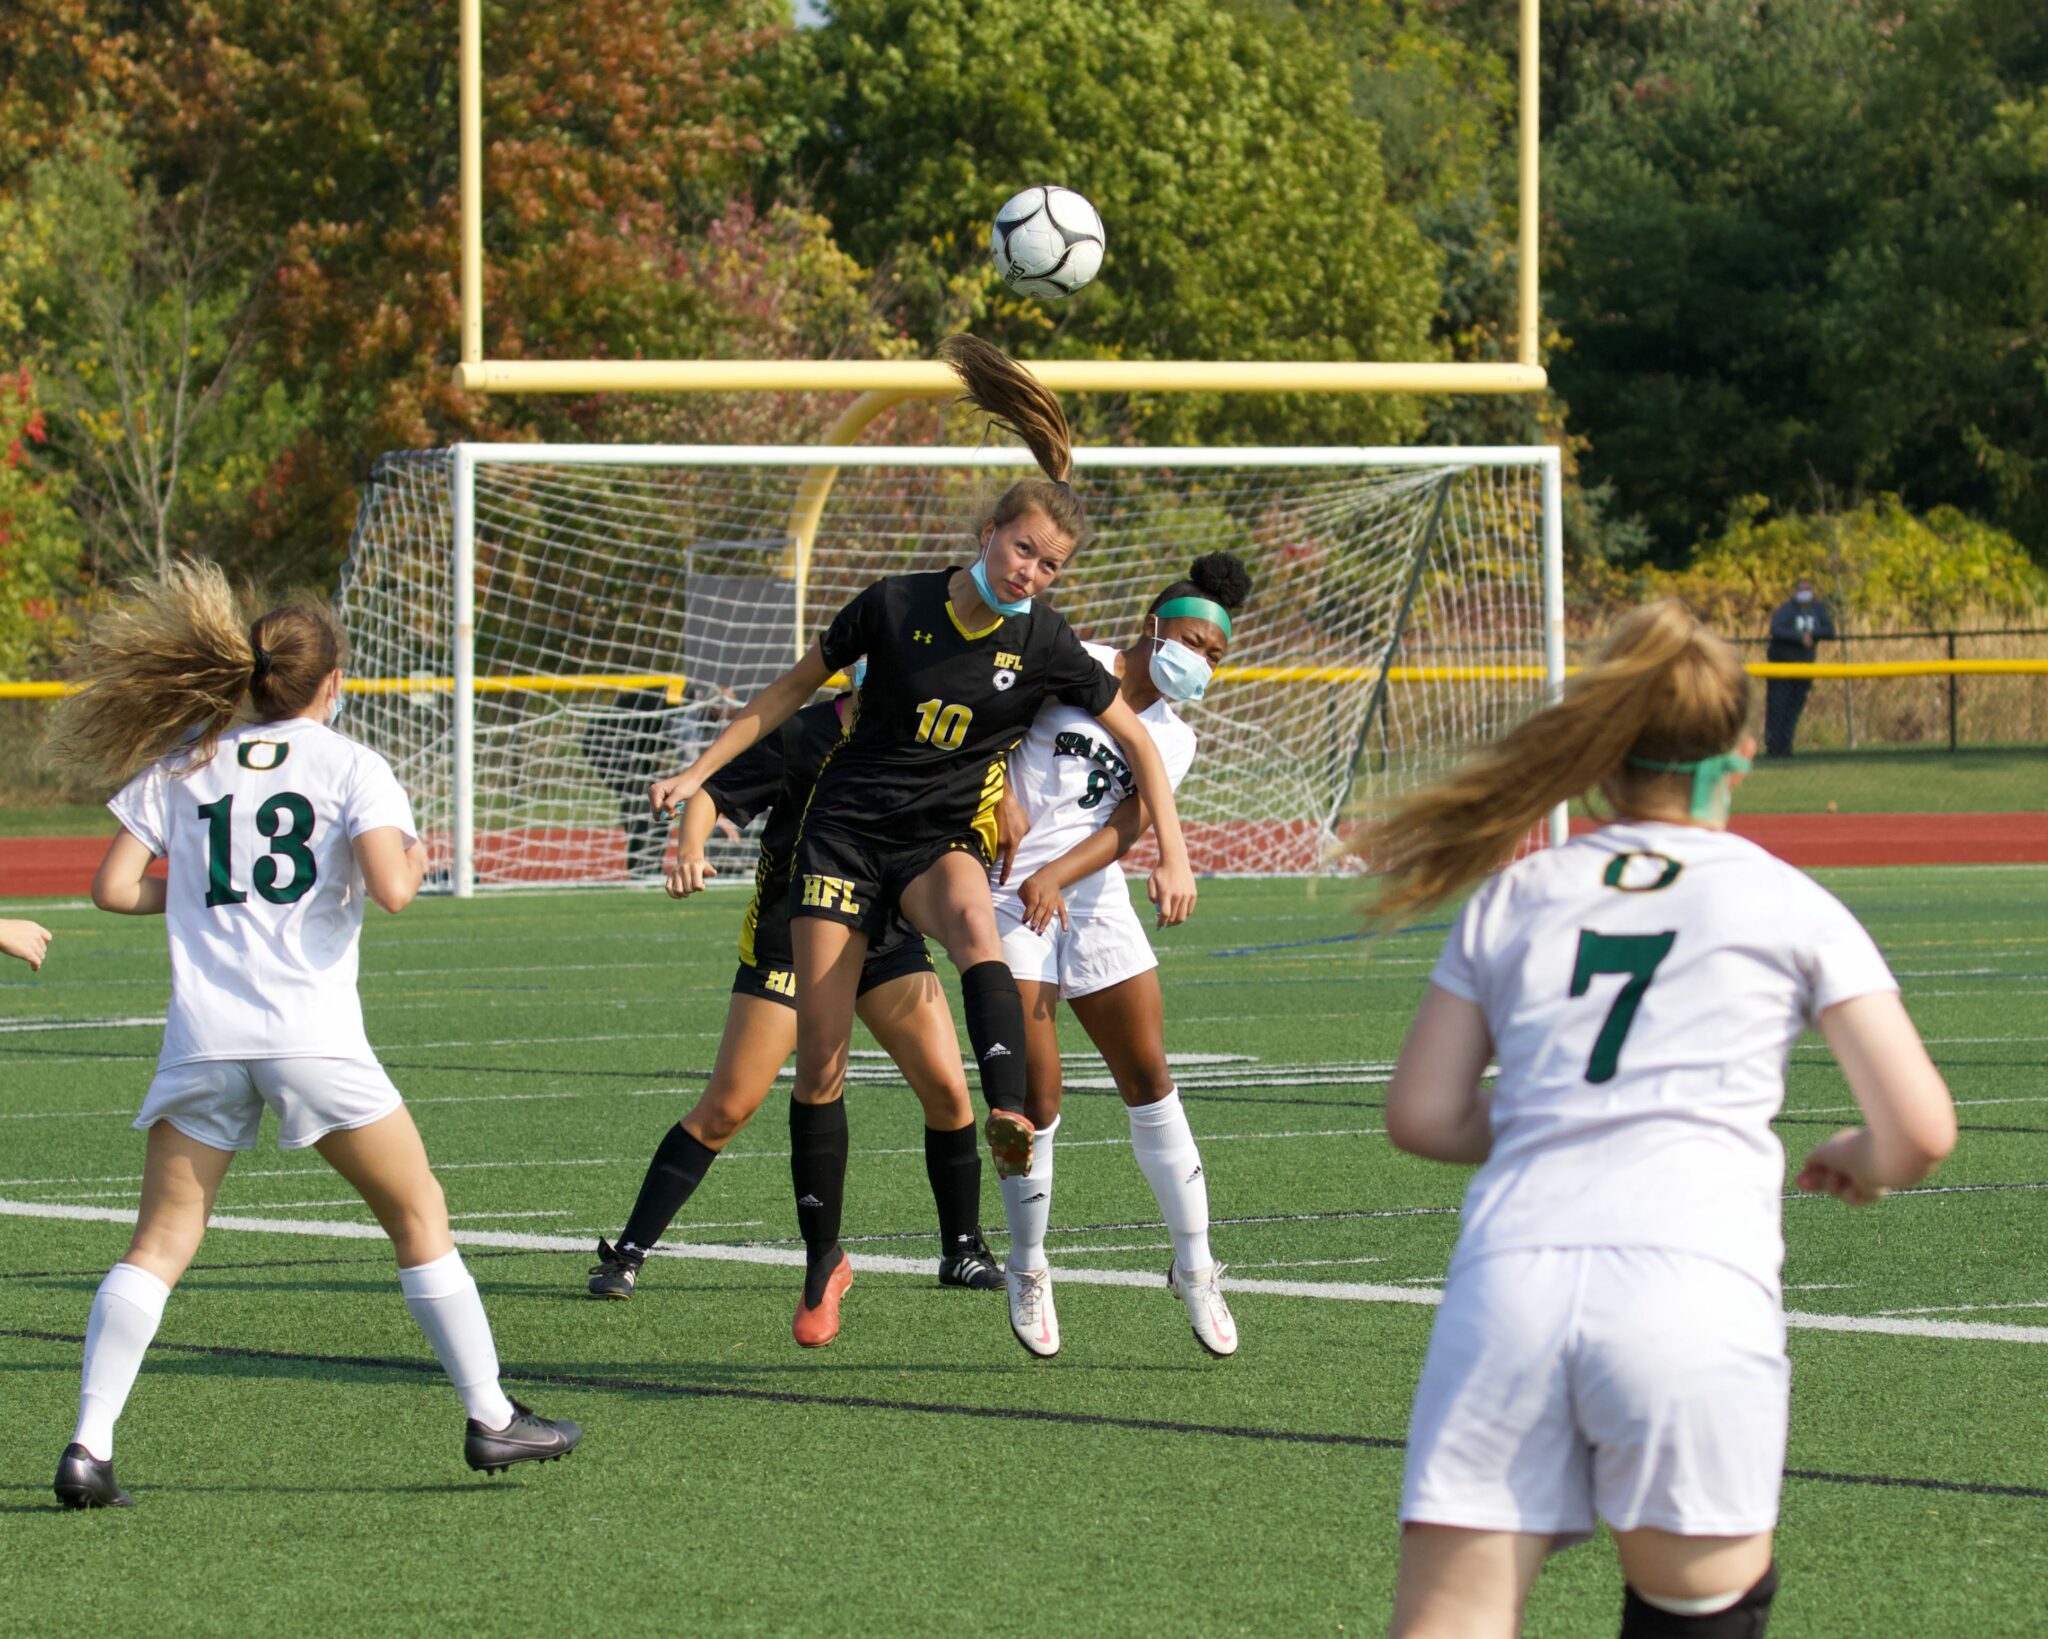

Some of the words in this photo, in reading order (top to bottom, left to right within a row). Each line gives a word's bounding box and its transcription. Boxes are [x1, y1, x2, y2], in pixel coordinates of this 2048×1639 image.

[993, 651, 1023, 671] HFL
[915, 698, 973, 751] 10
[198, 791, 317, 909] 13
[801, 874, 860, 915] HFL
[1568, 928, 1678, 1084] 7
